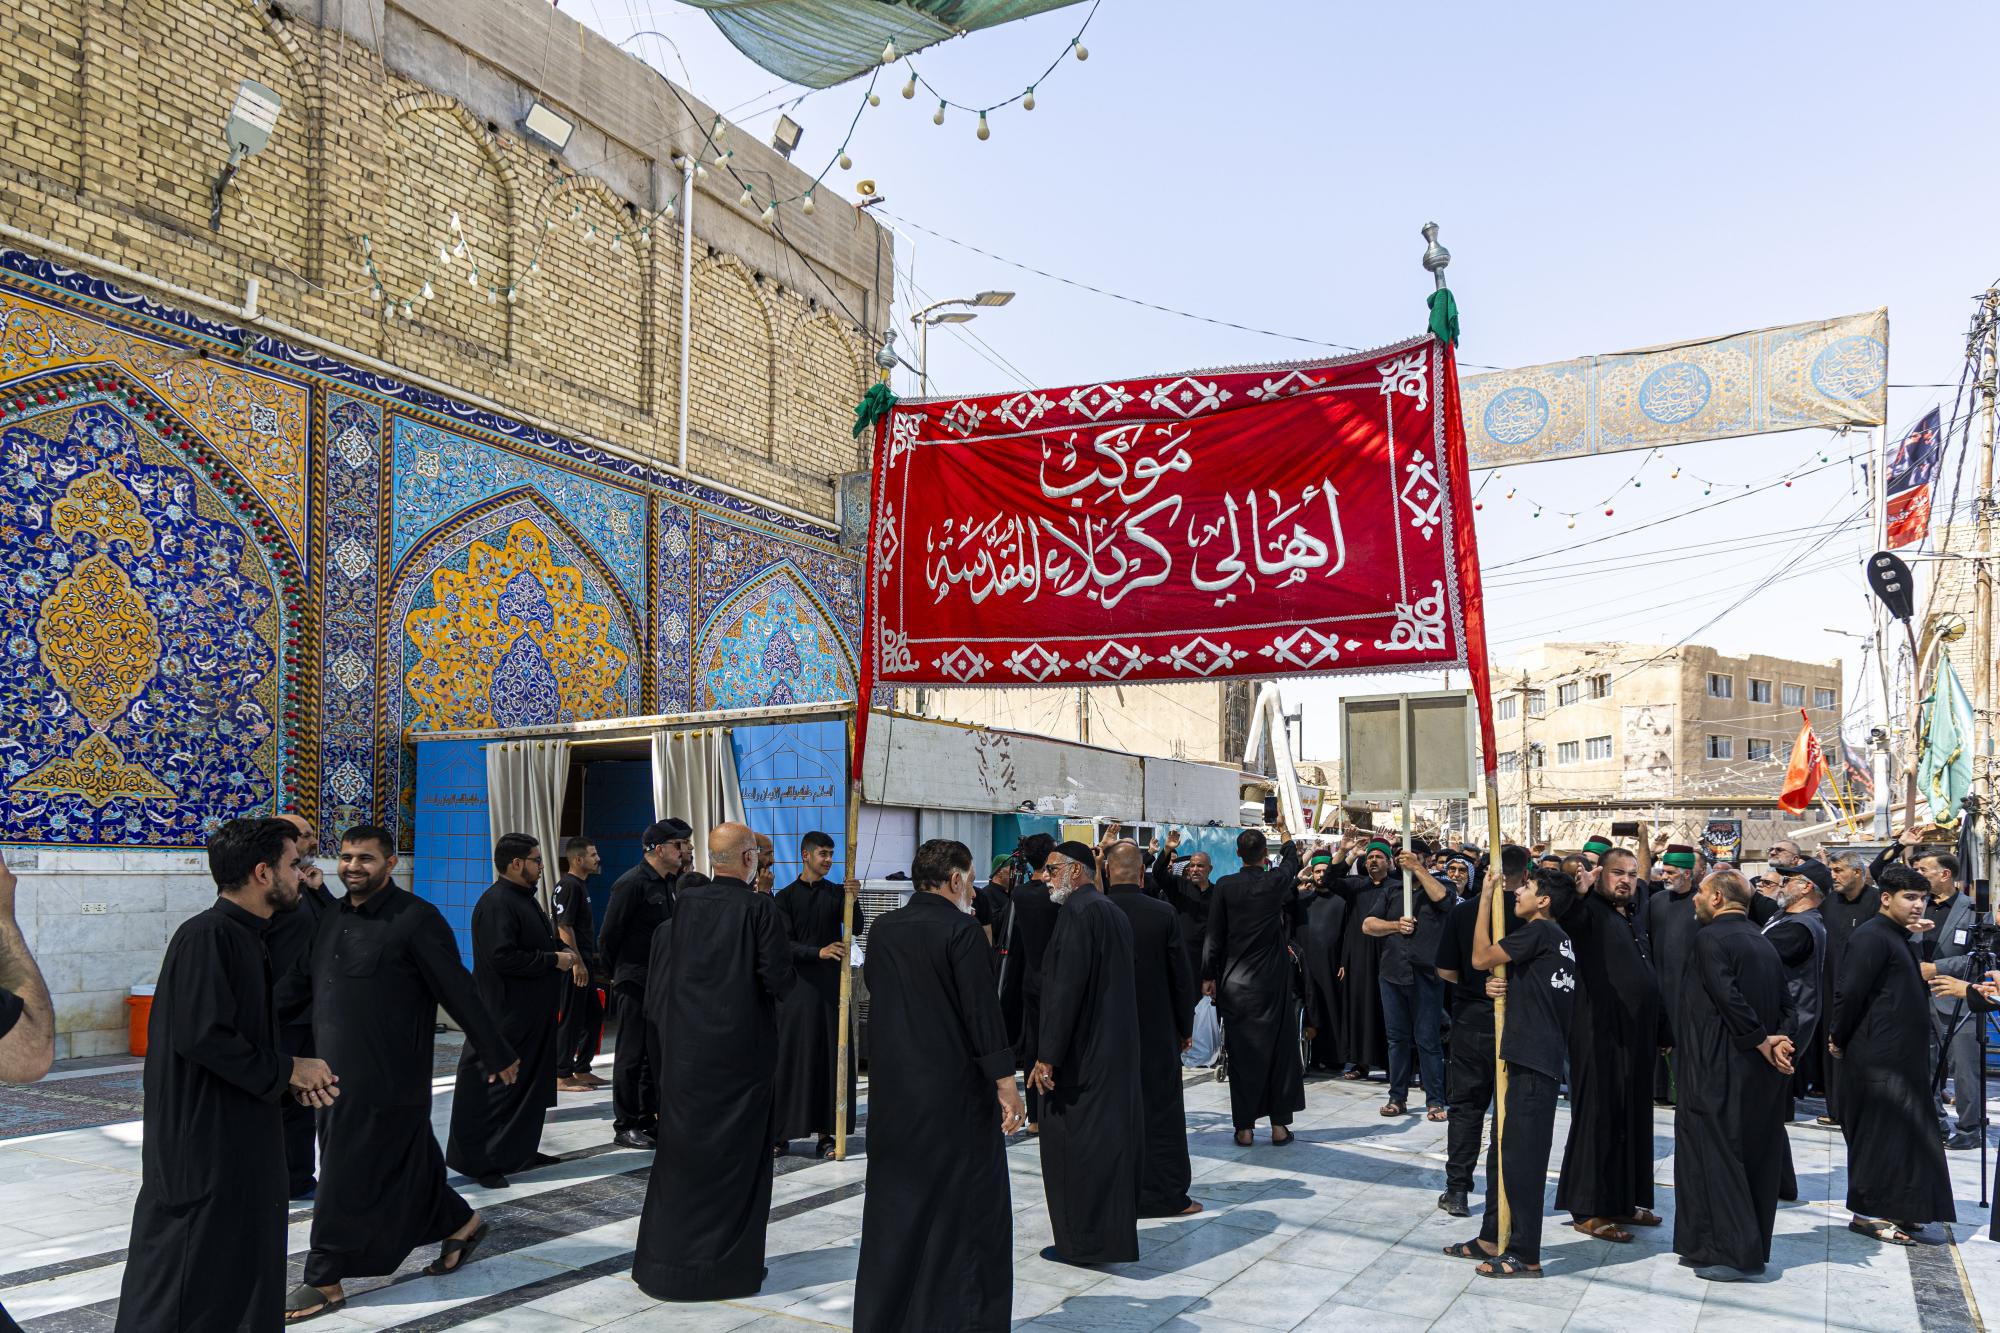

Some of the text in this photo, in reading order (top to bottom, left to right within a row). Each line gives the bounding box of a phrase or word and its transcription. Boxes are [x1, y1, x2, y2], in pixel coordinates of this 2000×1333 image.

[1039, 422, 1193, 508] موكب
[925, 476, 1346, 609] أهالي كربلاء المقدسة
